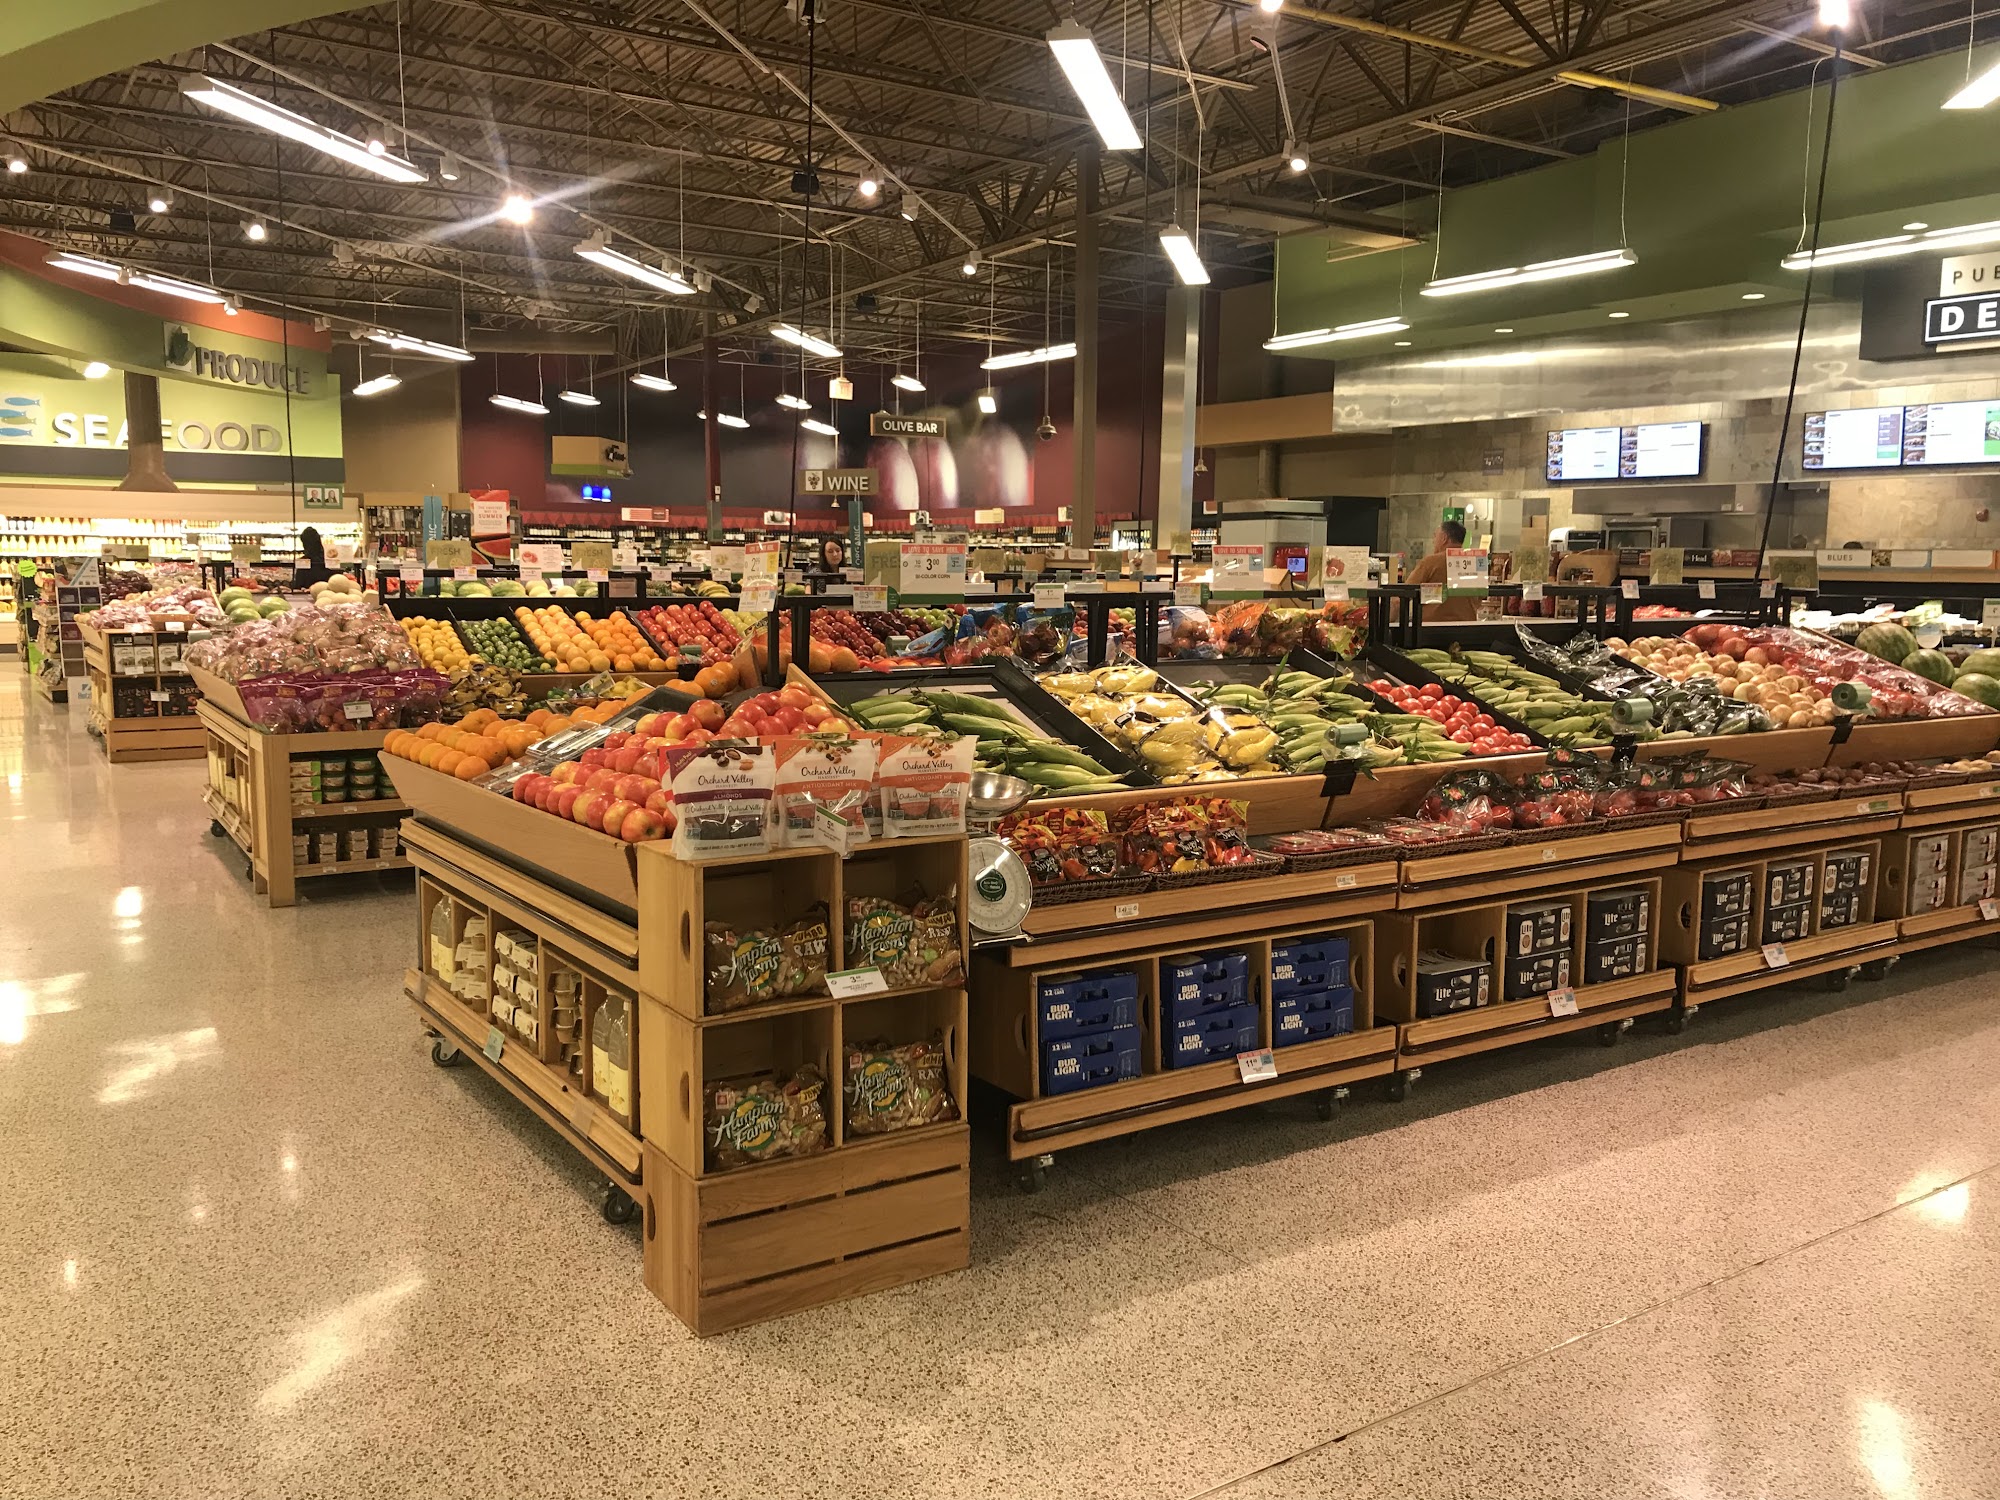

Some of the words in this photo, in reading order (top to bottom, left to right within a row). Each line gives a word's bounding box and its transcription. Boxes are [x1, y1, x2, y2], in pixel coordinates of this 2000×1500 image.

[196, 347, 311, 394] PRODUCE
[883, 420, 914, 432] OLIVE
[916, 422, 938, 434] BAR
[827, 476, 869, 491] WINE
[902, 760, 931, 771] Orchard
[931, 759, 953, 771] Valley
[801, 766, 832, 777] Orchard
[833, 765, 856, 777] Valley
[697, 774, 729, 785] Orchard
[731, 774, 754, 787] Valley
[802, 782, 844, 790] ANTIOXIDANT
[713, 792, 743, 800] ALMONDS
[1604, 912, 1619, 926] Lite
[1521, 924, 1532, 935] Lite
[846, 918, 915, 955] Hampton
[793, 939, 827, 958] RAW
[1601, 955, 1615, 969] Lite
[1176, 969, 1184, 978] 12
[1275, 964, 1293, 973] BUD
[1272, 971, 1296, 980] LIGHT
[1520, 971, 1535, 985] Lite
[1181, 984, 1198, 993] BUD
[1178, 990, 1201, 1001] LIGHT
[1435, 988, 1452, 1002] Lite
[1050, 1003, 1070, 1013] BUD
[1046, 1010, 1074, 1021] LIGHT
[1283, 1014, 1300, 1023] BUD
[1280, 1020, 1303, 1030] LIGHT
[1182, 1034, 1200, 1044] BUD
[1179, 1041, 1203, 1051] LIGHT
[1057, 1057, 1077, 1068] BUD
[1054, 1064, 1081, 1076] LIGHT
[713, 1101, 784, 1148] Hampton
[735, 1116, 779, 1151] Farms
